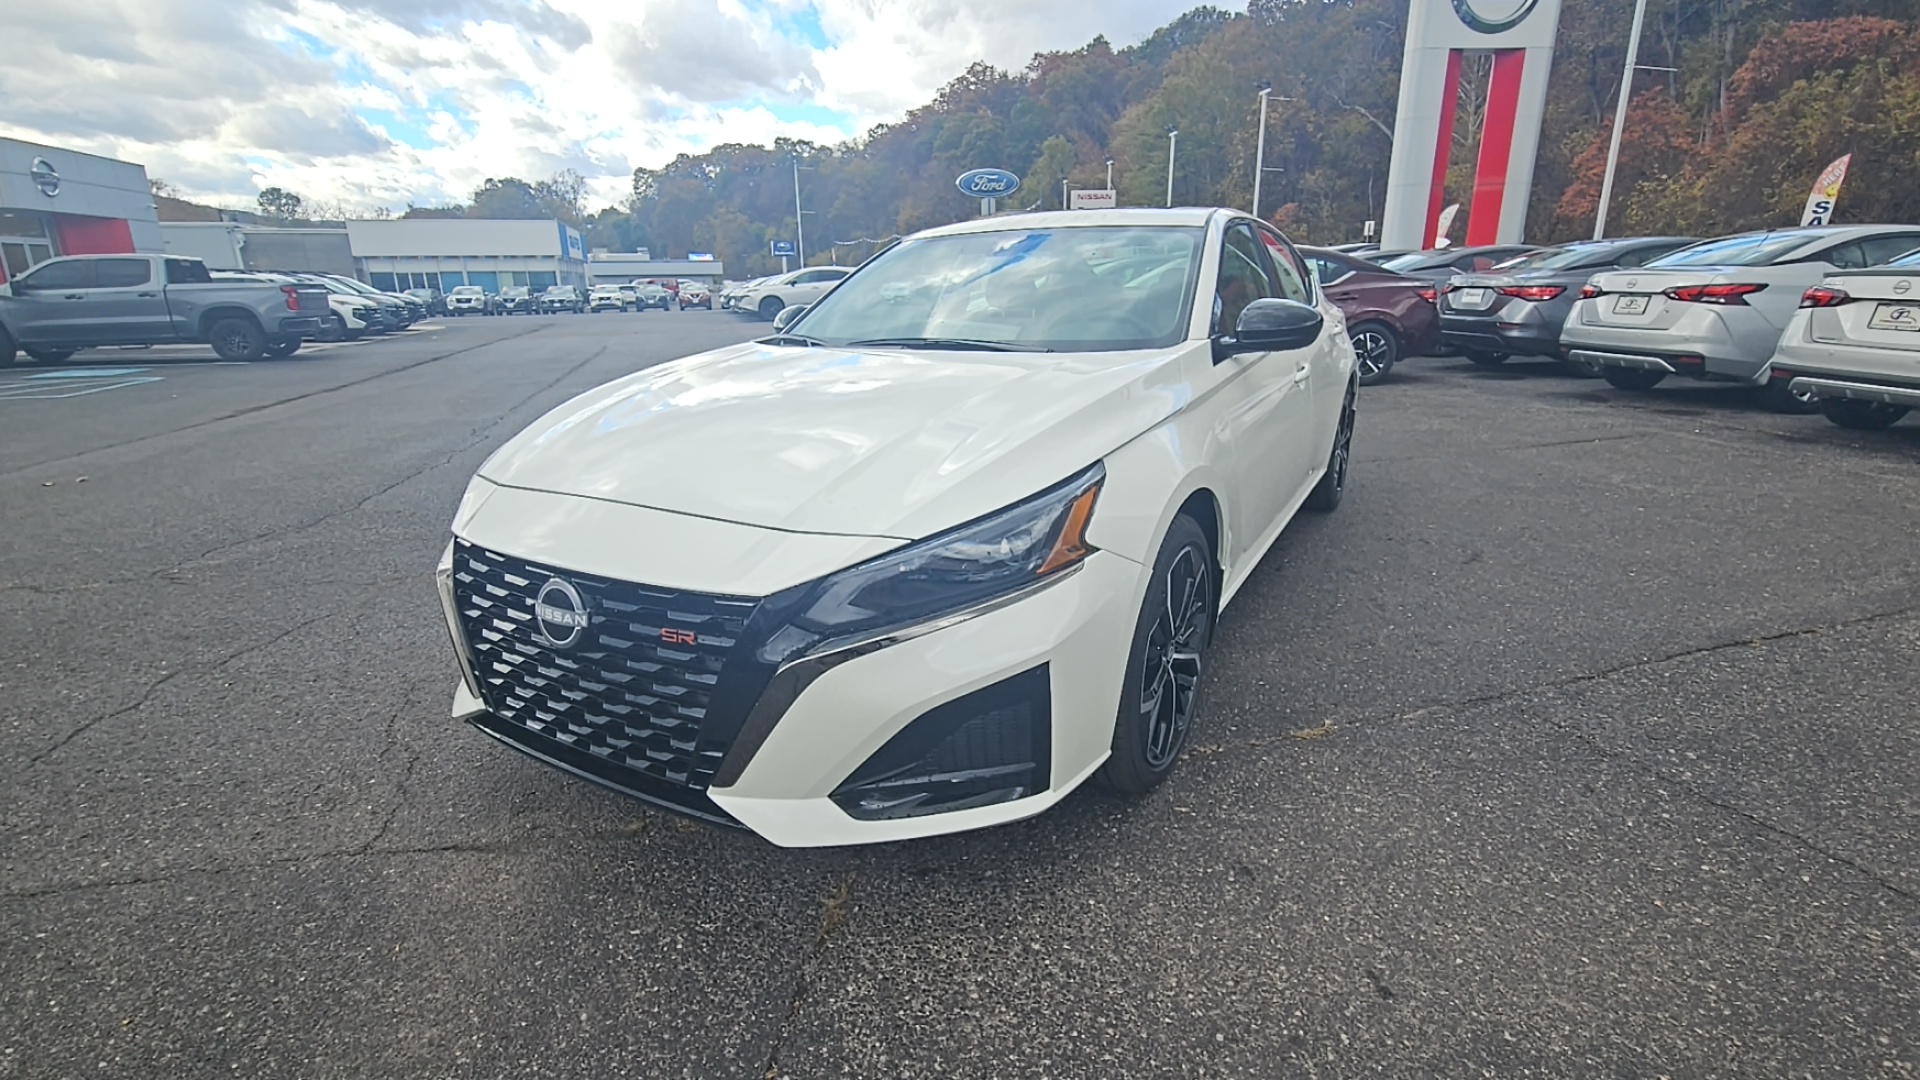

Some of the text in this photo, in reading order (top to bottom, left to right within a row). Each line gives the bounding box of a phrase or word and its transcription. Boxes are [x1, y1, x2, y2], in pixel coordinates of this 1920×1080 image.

[971, 174, 1007, 191] Ford
[537, 604, 586, 626] NISSAN
[661, 628, 696, 645] SR
